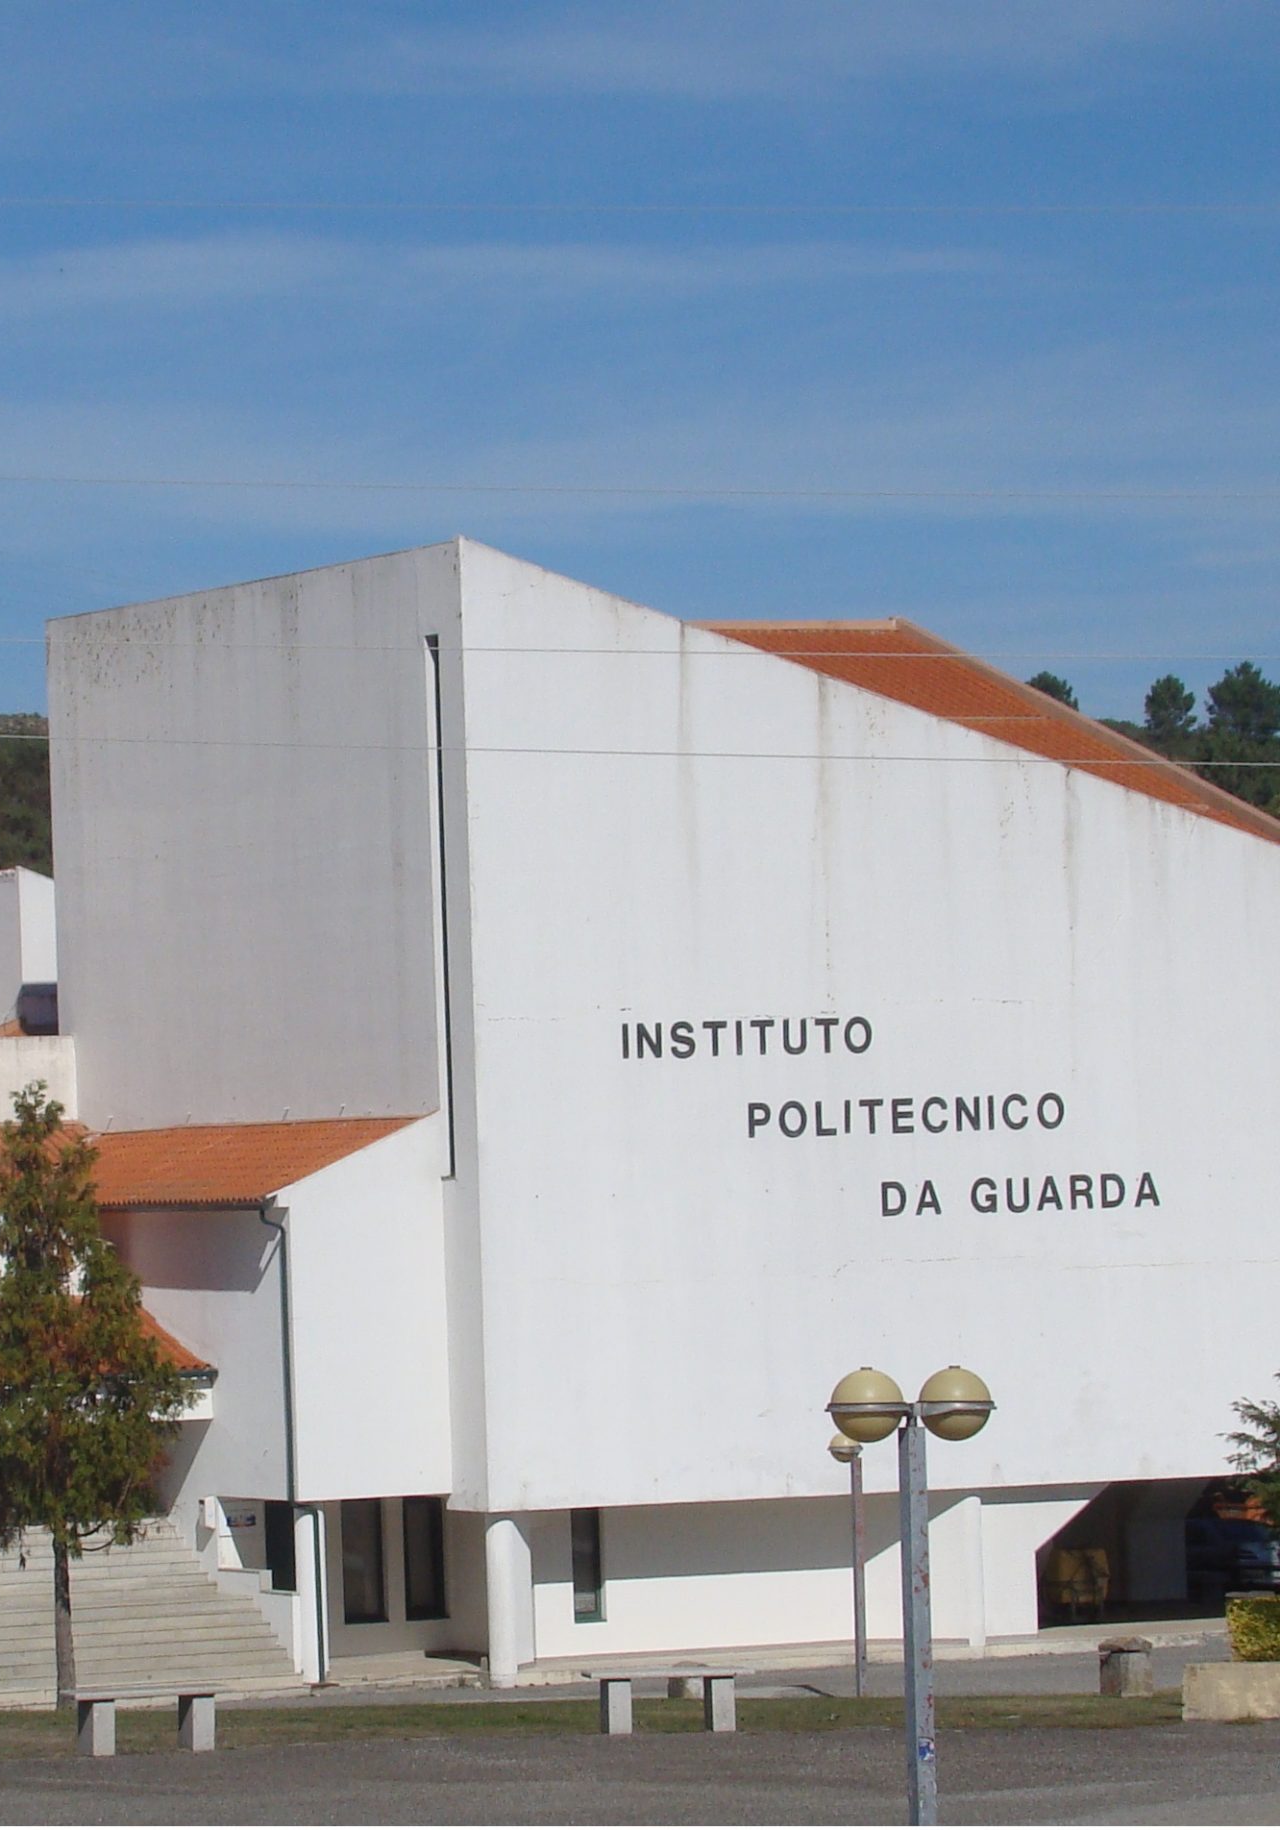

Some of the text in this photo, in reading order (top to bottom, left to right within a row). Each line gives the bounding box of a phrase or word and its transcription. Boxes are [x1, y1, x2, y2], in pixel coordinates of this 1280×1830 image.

[621, 1016, 873, 1060] INSTITUTO
[747, 1092, 1065, 1139] POLITECNICO
[880, 1171, 1160, 1217] DA GUARDA
